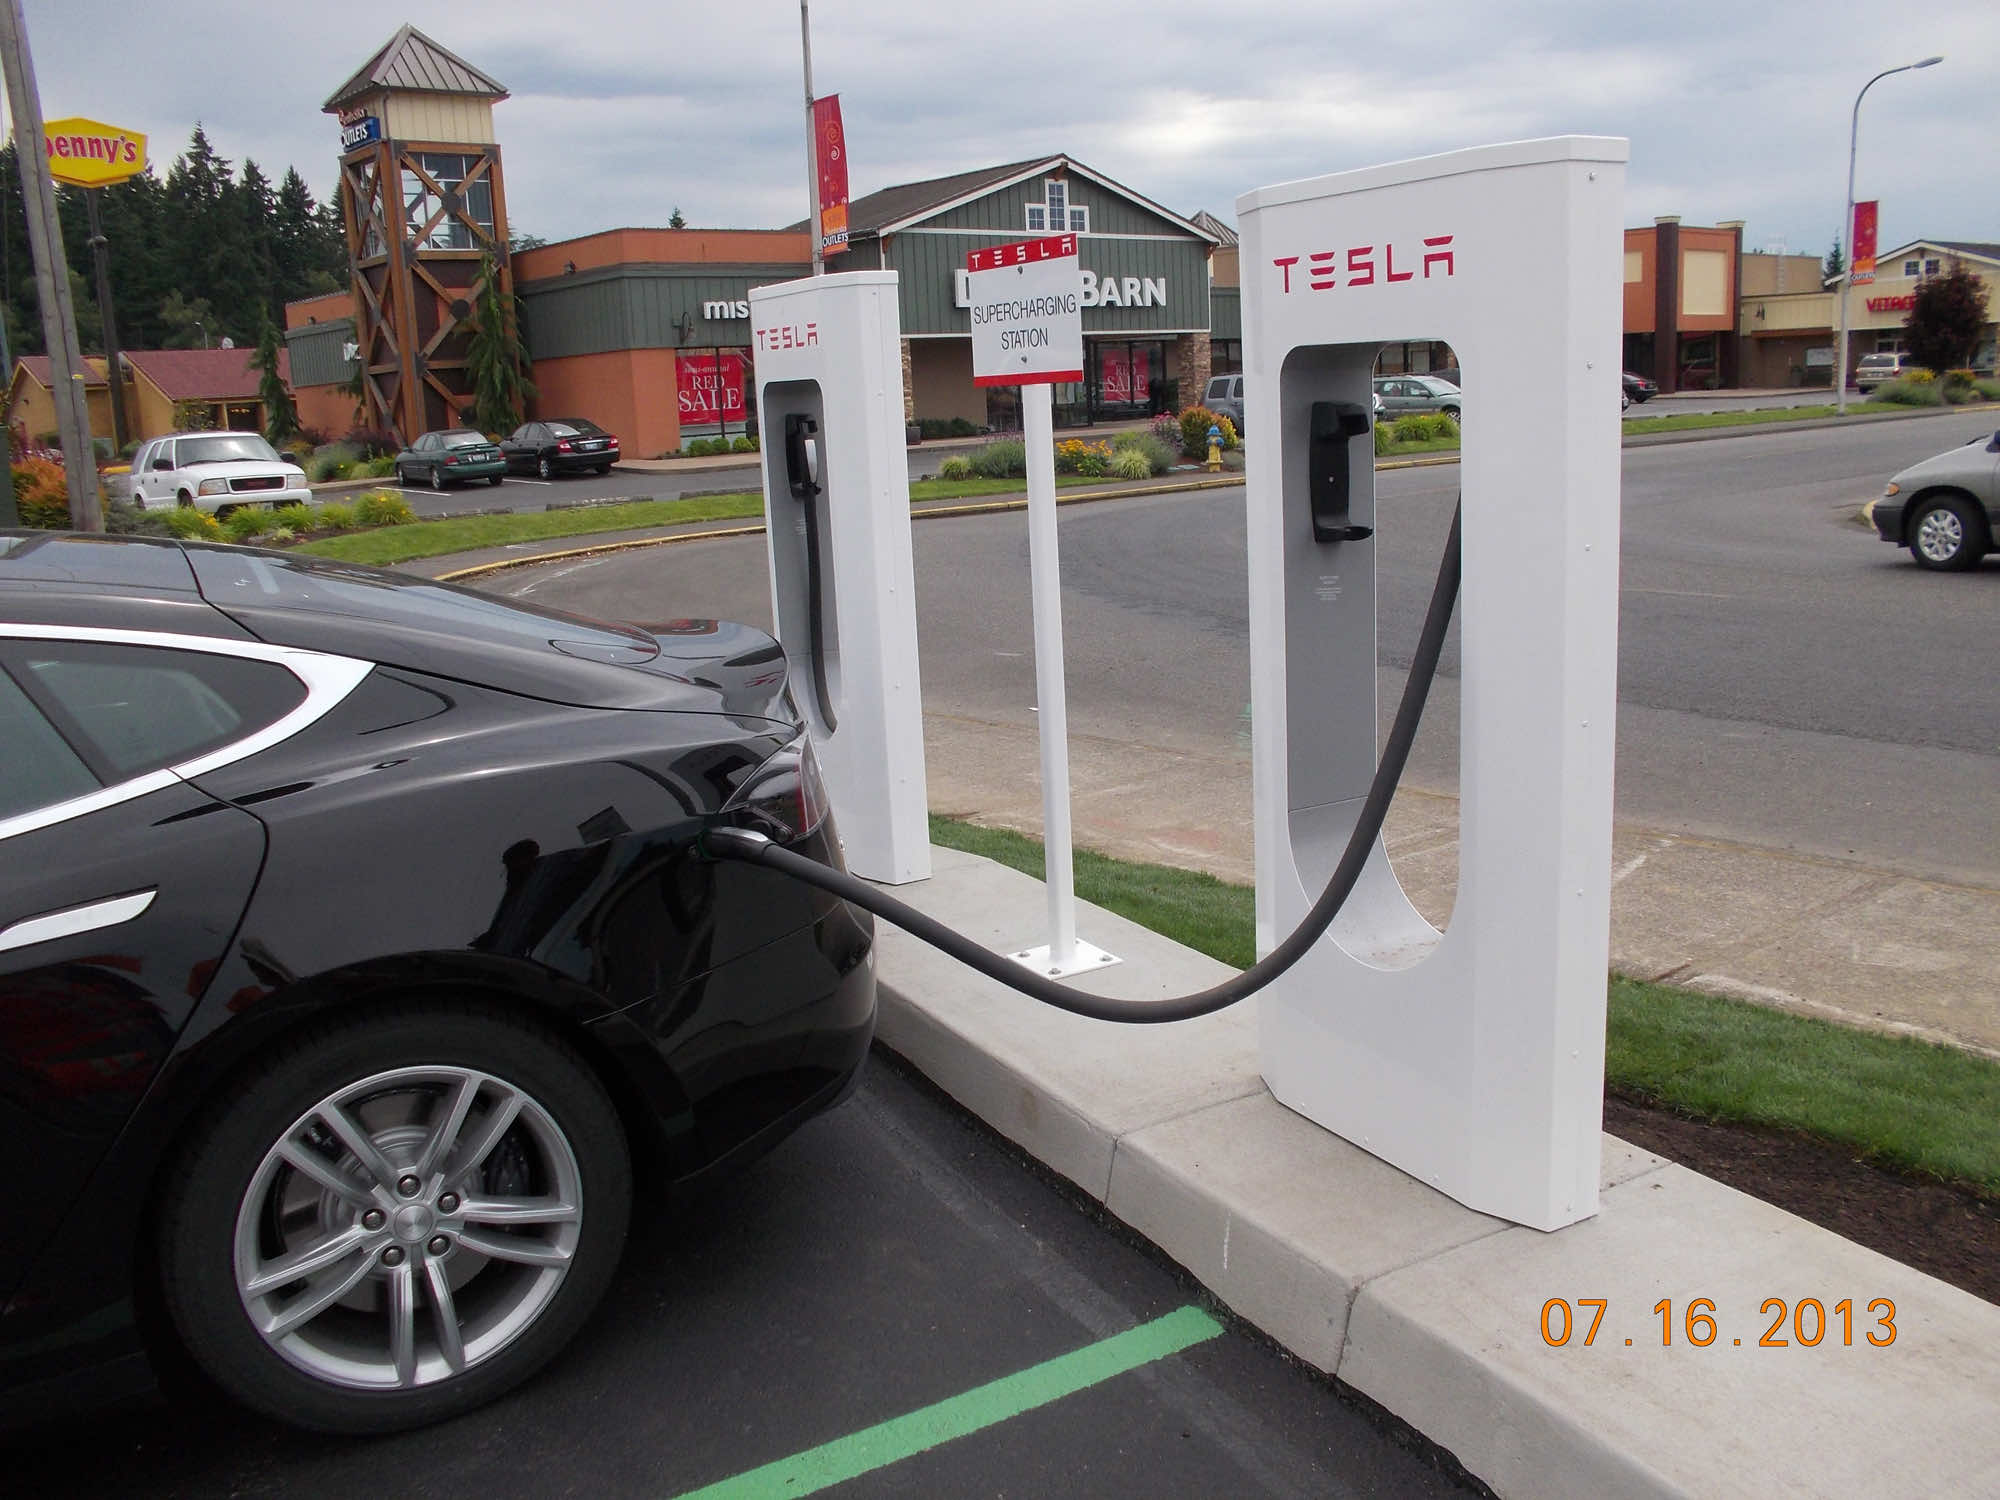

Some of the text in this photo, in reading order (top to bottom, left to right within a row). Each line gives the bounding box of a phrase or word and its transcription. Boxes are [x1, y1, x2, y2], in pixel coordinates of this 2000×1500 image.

[822, 232, 849, 248] OUTLETS
[972, 237, 1073, 269] TESLA
[1273, 235, 1454, 293] TESLA
[1079, 270, 1166, 307] BARN
[974, 294, 1077, 325] SUPERCHARGING
[757, 323, 818, 351] TESLA
[1001, 328, 1049, 350] STATION
[692, 375, 725, 390] RED
[1107, 375, 1146, 392] SALE
[678, 387, 741, 412] SALE
